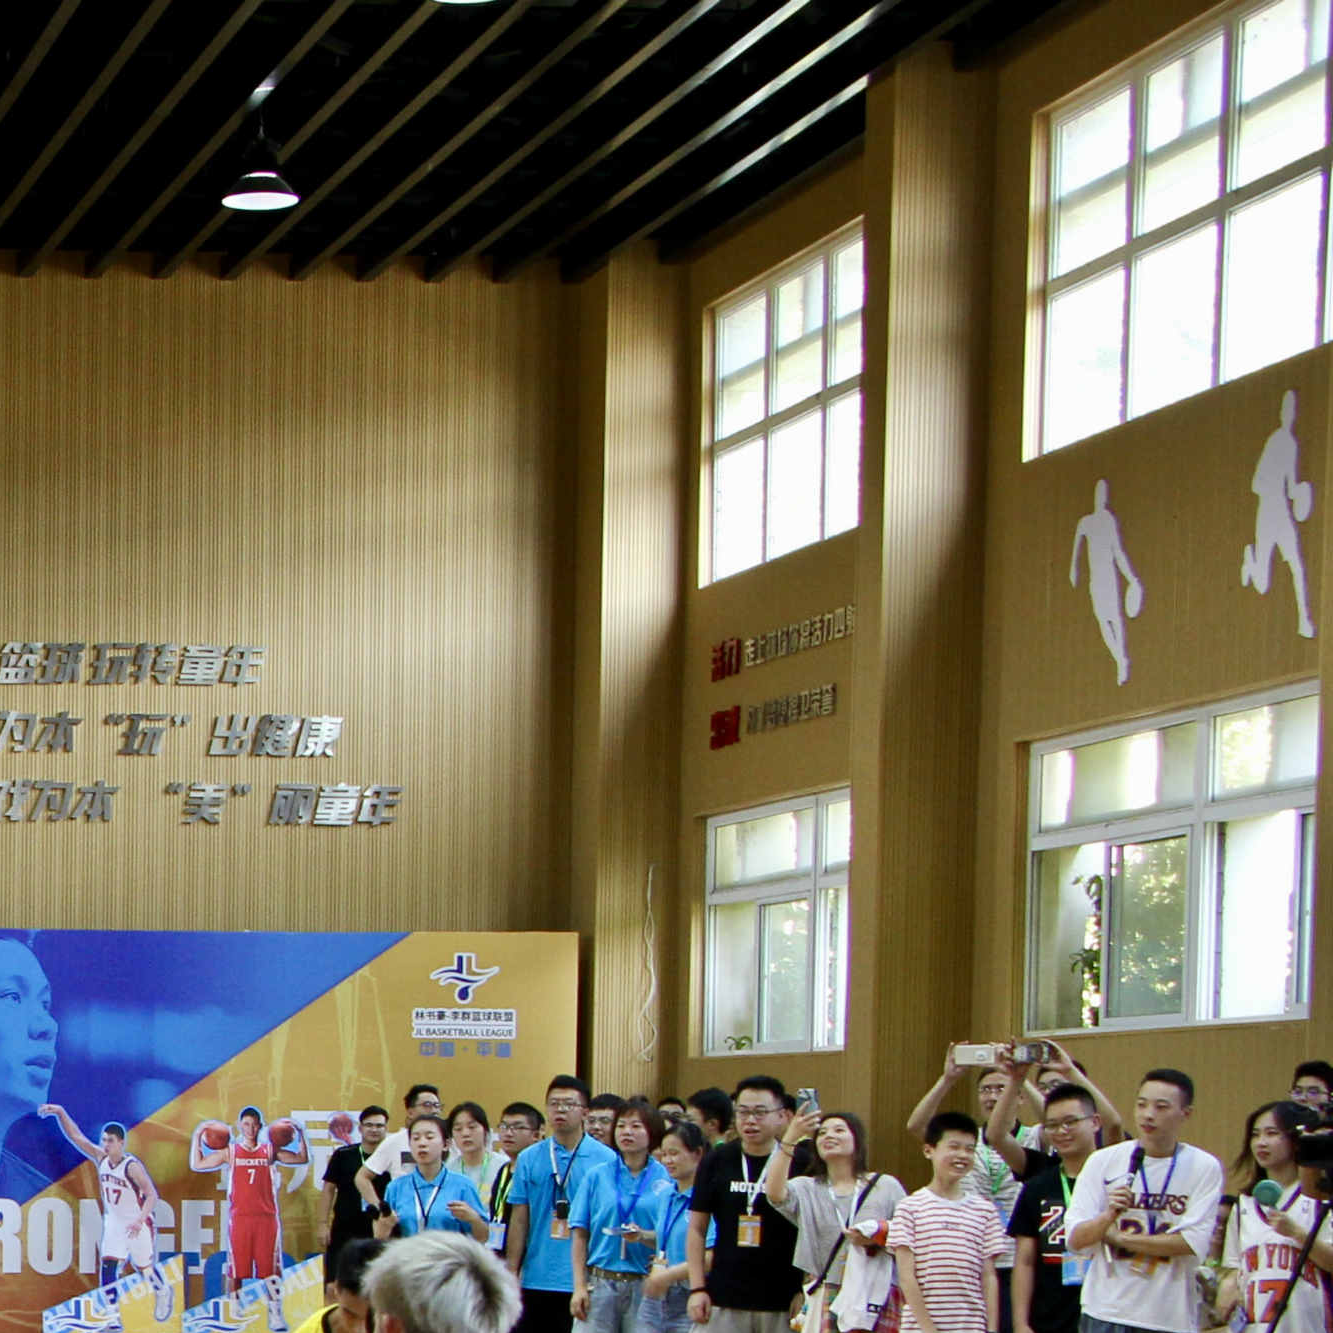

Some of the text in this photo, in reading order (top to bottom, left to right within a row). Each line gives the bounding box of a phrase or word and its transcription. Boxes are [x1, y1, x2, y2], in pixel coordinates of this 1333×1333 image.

[425, 1028, 479, 1037] BASKETBALL
[480, 1028, 514, 1037] LEAGUE
[247, 1168, 256, 1185] 7
[105, 1187, 122, 1205] 17
[1129, 1192, 1188, 1215] AKERS
